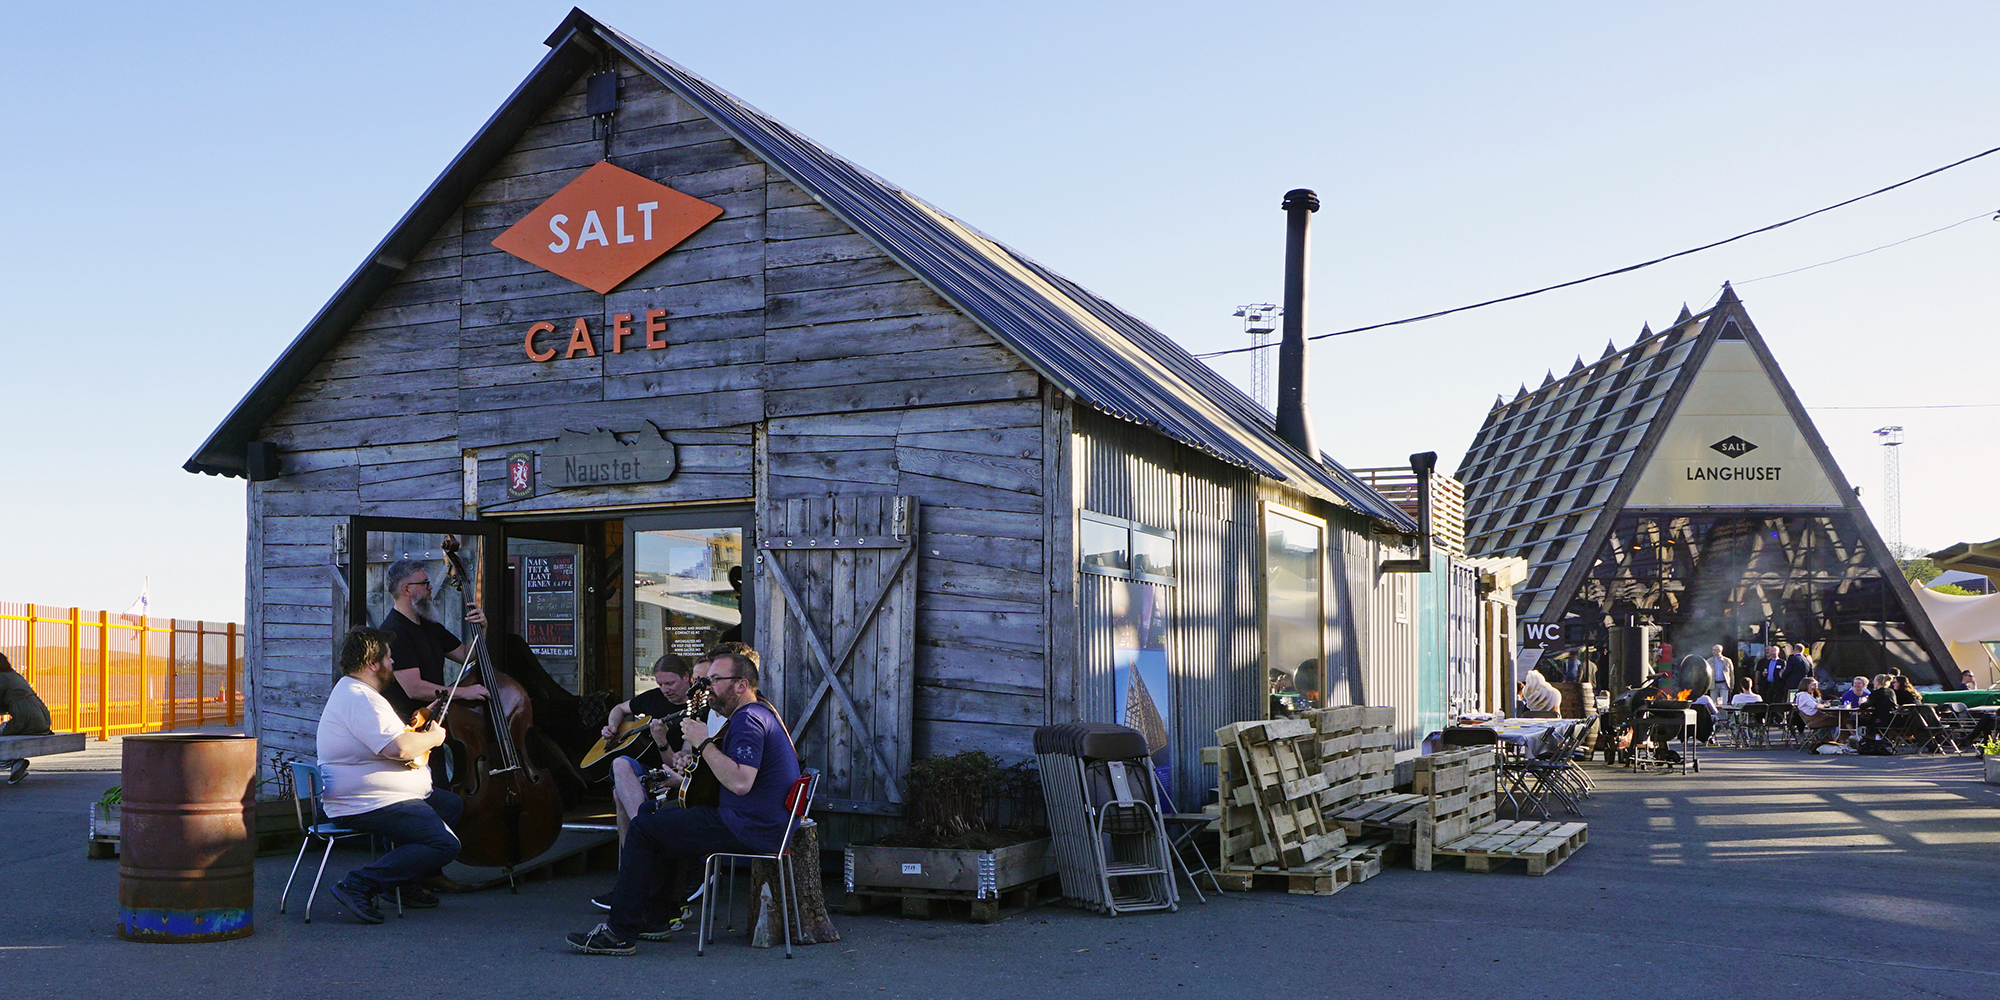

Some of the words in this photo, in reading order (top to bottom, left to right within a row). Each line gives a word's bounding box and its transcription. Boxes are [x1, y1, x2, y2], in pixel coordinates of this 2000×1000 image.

[548, 201, 659, 254] SALT
[524, 308, 667, 362] CAFE
[1721, 443, 1746, 451] SALT
[565, 456, 641, 484] Naustet
[1687, 467, 1781, 481] LANGHUSET
[528, 624, 554, 636] BAR
[1526, 624, 1560, 640] WC
